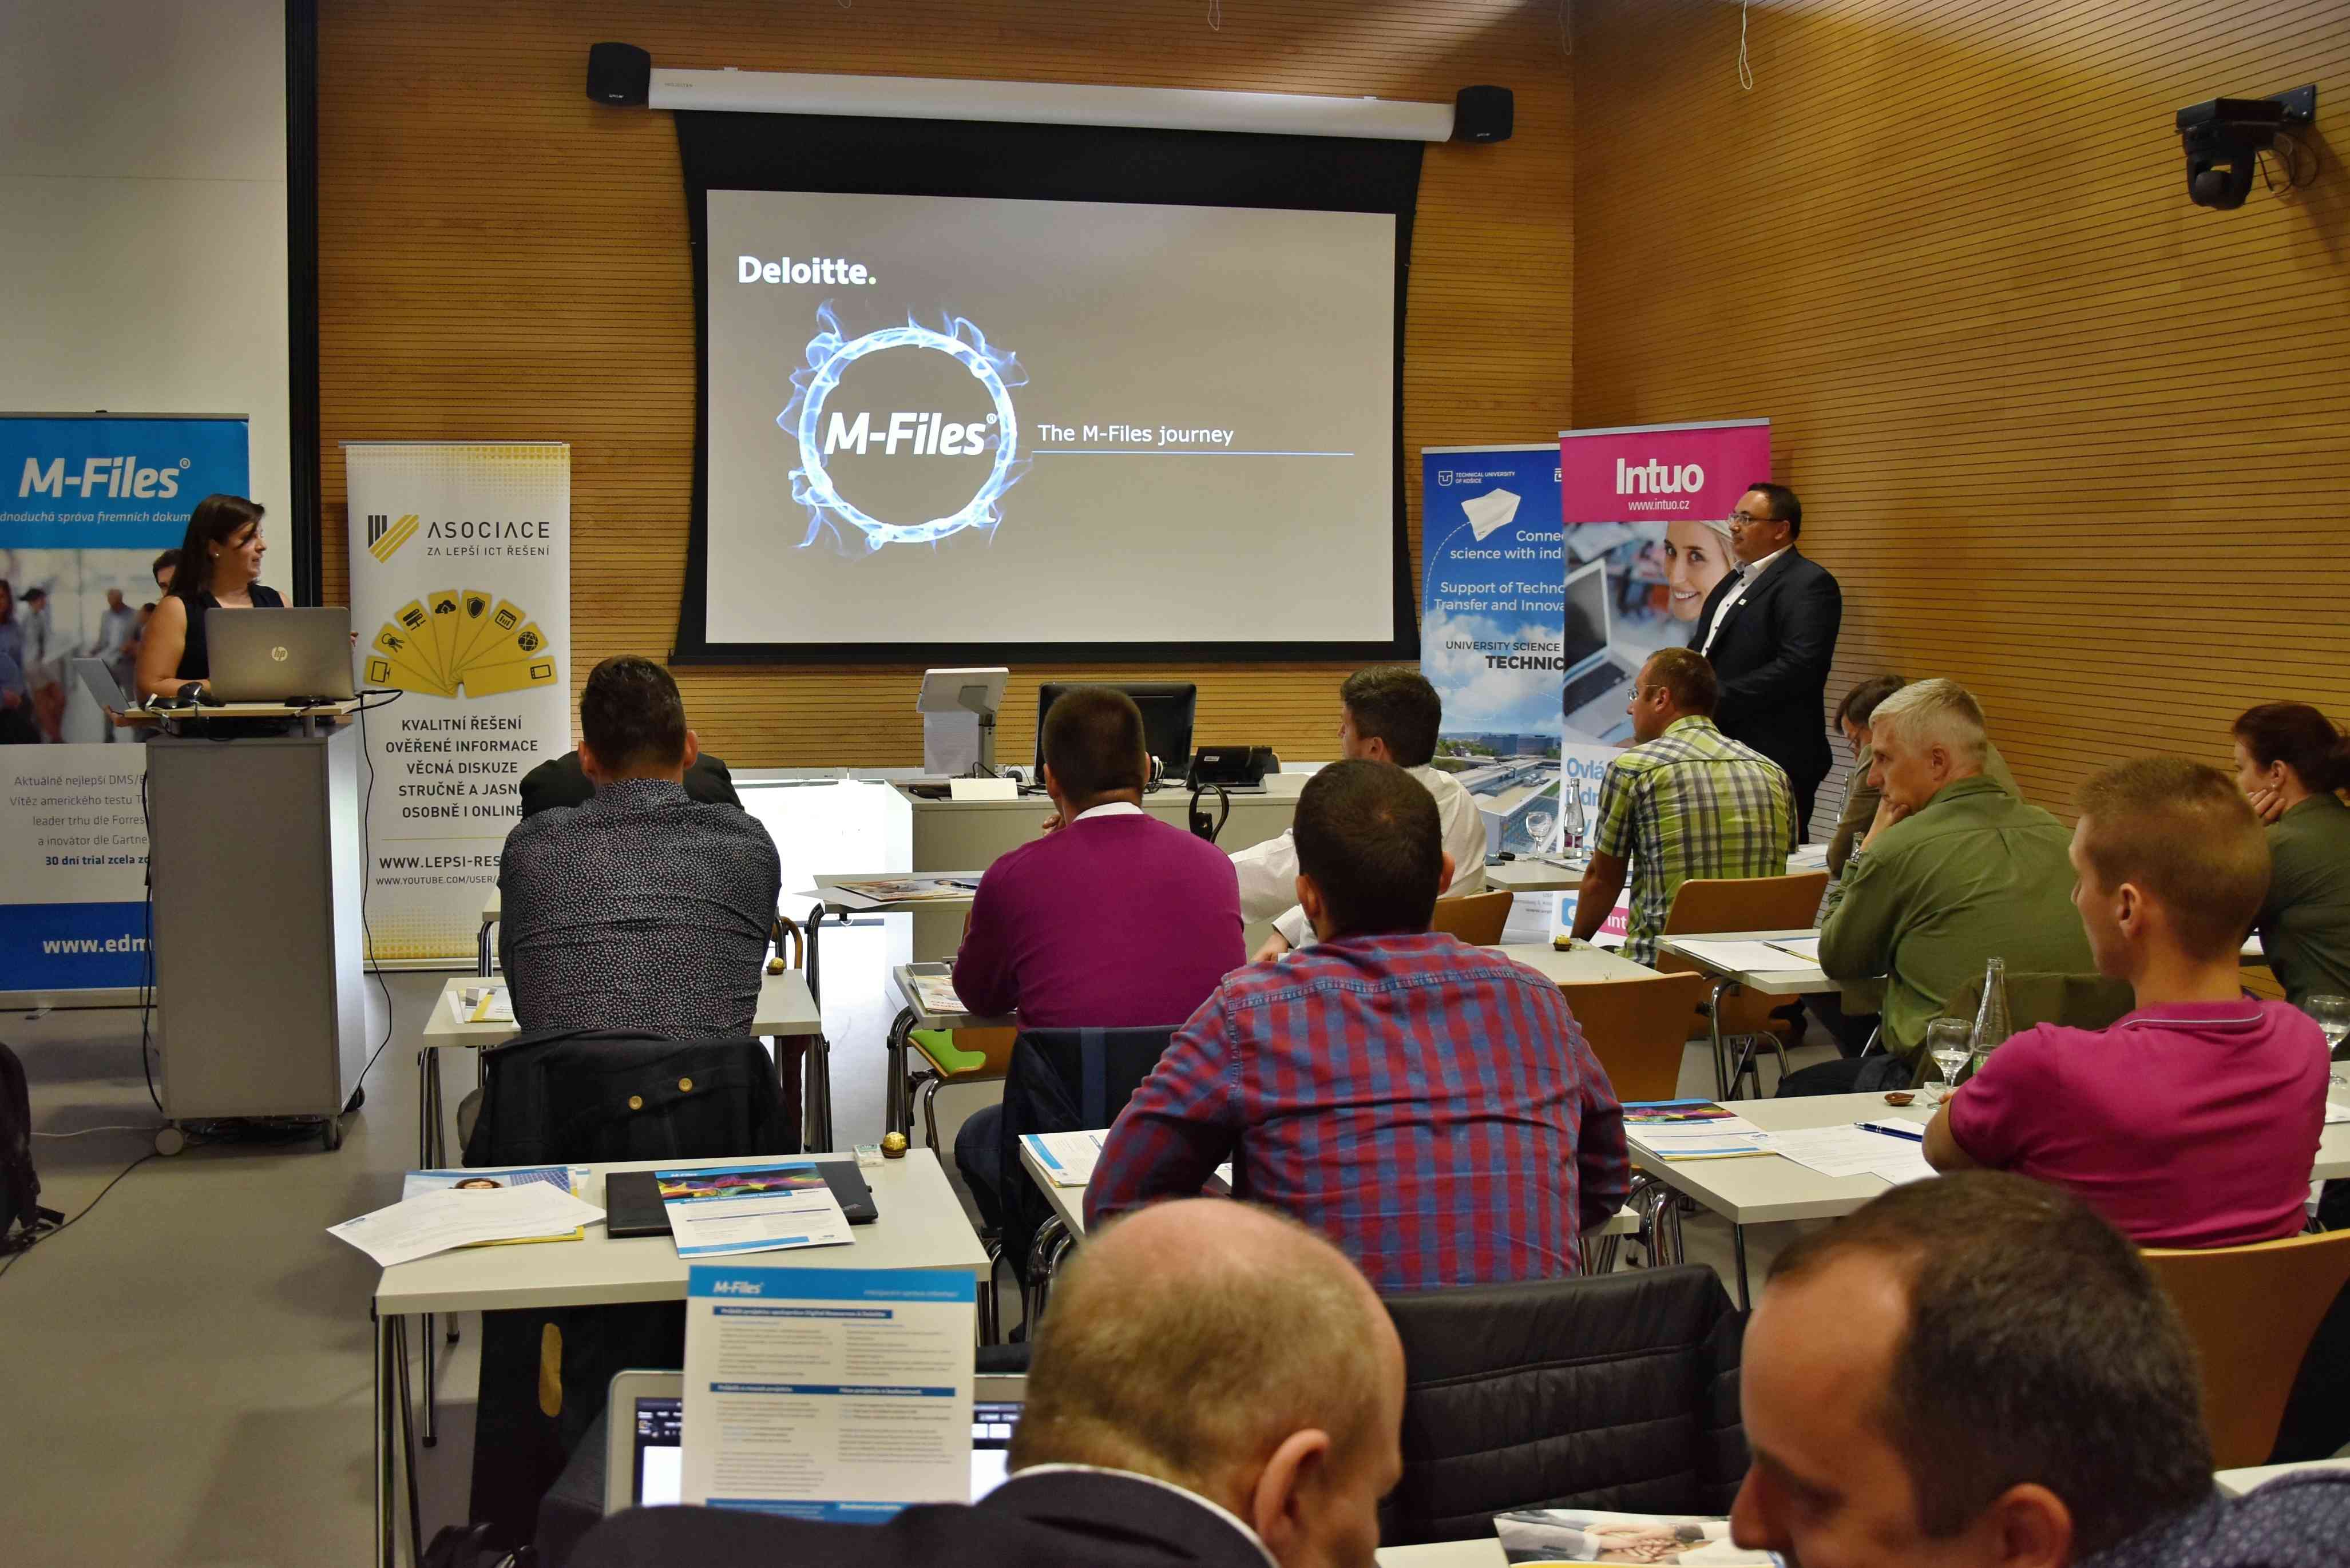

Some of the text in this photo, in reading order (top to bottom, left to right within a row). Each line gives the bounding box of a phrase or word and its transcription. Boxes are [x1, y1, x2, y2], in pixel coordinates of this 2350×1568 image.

[739, 256, 877, 285] Deloitte.
[1037, 424, 1234, 446] The M-Files journey
[1616, 458, 1705, 494] Intuo
[1628, 498, 1690, 511] www.intuo.cz
[58, 512, 94, 523] správa
[97, 511, 149, 524] firemních
[427, 521, 550, 538] ASOCIACE
[427, 545, 550, 556] ZA LEPŠÍ ICT ŘEŠENÍ
[1450, 547, 1501, 559] science
[1501, 547, 1536, 559] with
[1440, 581, 1496, 596] Support
[1499, 581, 1513, 594] of
[1434, 598, 1488, 611] Transfer
[1491, 600, 1517, 611] and
[1446, 641, 1561, 652] UNIVERSITY SCIENCE
[1485, 655, 1565, 670] TECHNIC
[402, 715, 522, 731] KVALITNÍ ŘEŠENÍ
[386, 738, 538, 753] OVĚŘENÉ INFORMACE
[407, 760, 518, 774] VĚCNÁ DISKUZE
[14, 775, 62, 787] Aktuálně
[65, 773, 106, 787] nejlepší
[399, 781, 465, 796] STRUČNĚ
[469, 784, 478, 796] A
[10, 795, 37, 807] Vítěz
[41, 794, 101, 806] amerického
[105, 796, 132, 805] testu
[402, 803, 459, 817] OSOBNĚ
[472, 805, 523, 817] ONLINE
[33, 815, 65, 826] leader
[68, 815, 90, 826] trhu
[93, 815, 109, 825] dle
[38, 838, 44, 847] a
[47, 835, 91, 846] inovátor
[93, 835, 109, 845] dle
[46, 855, 58, 866] 30
[61, 855, 79, 866] dní
[82, 855, 105, 865] trial
[108, 854, 135, 864] zcela
